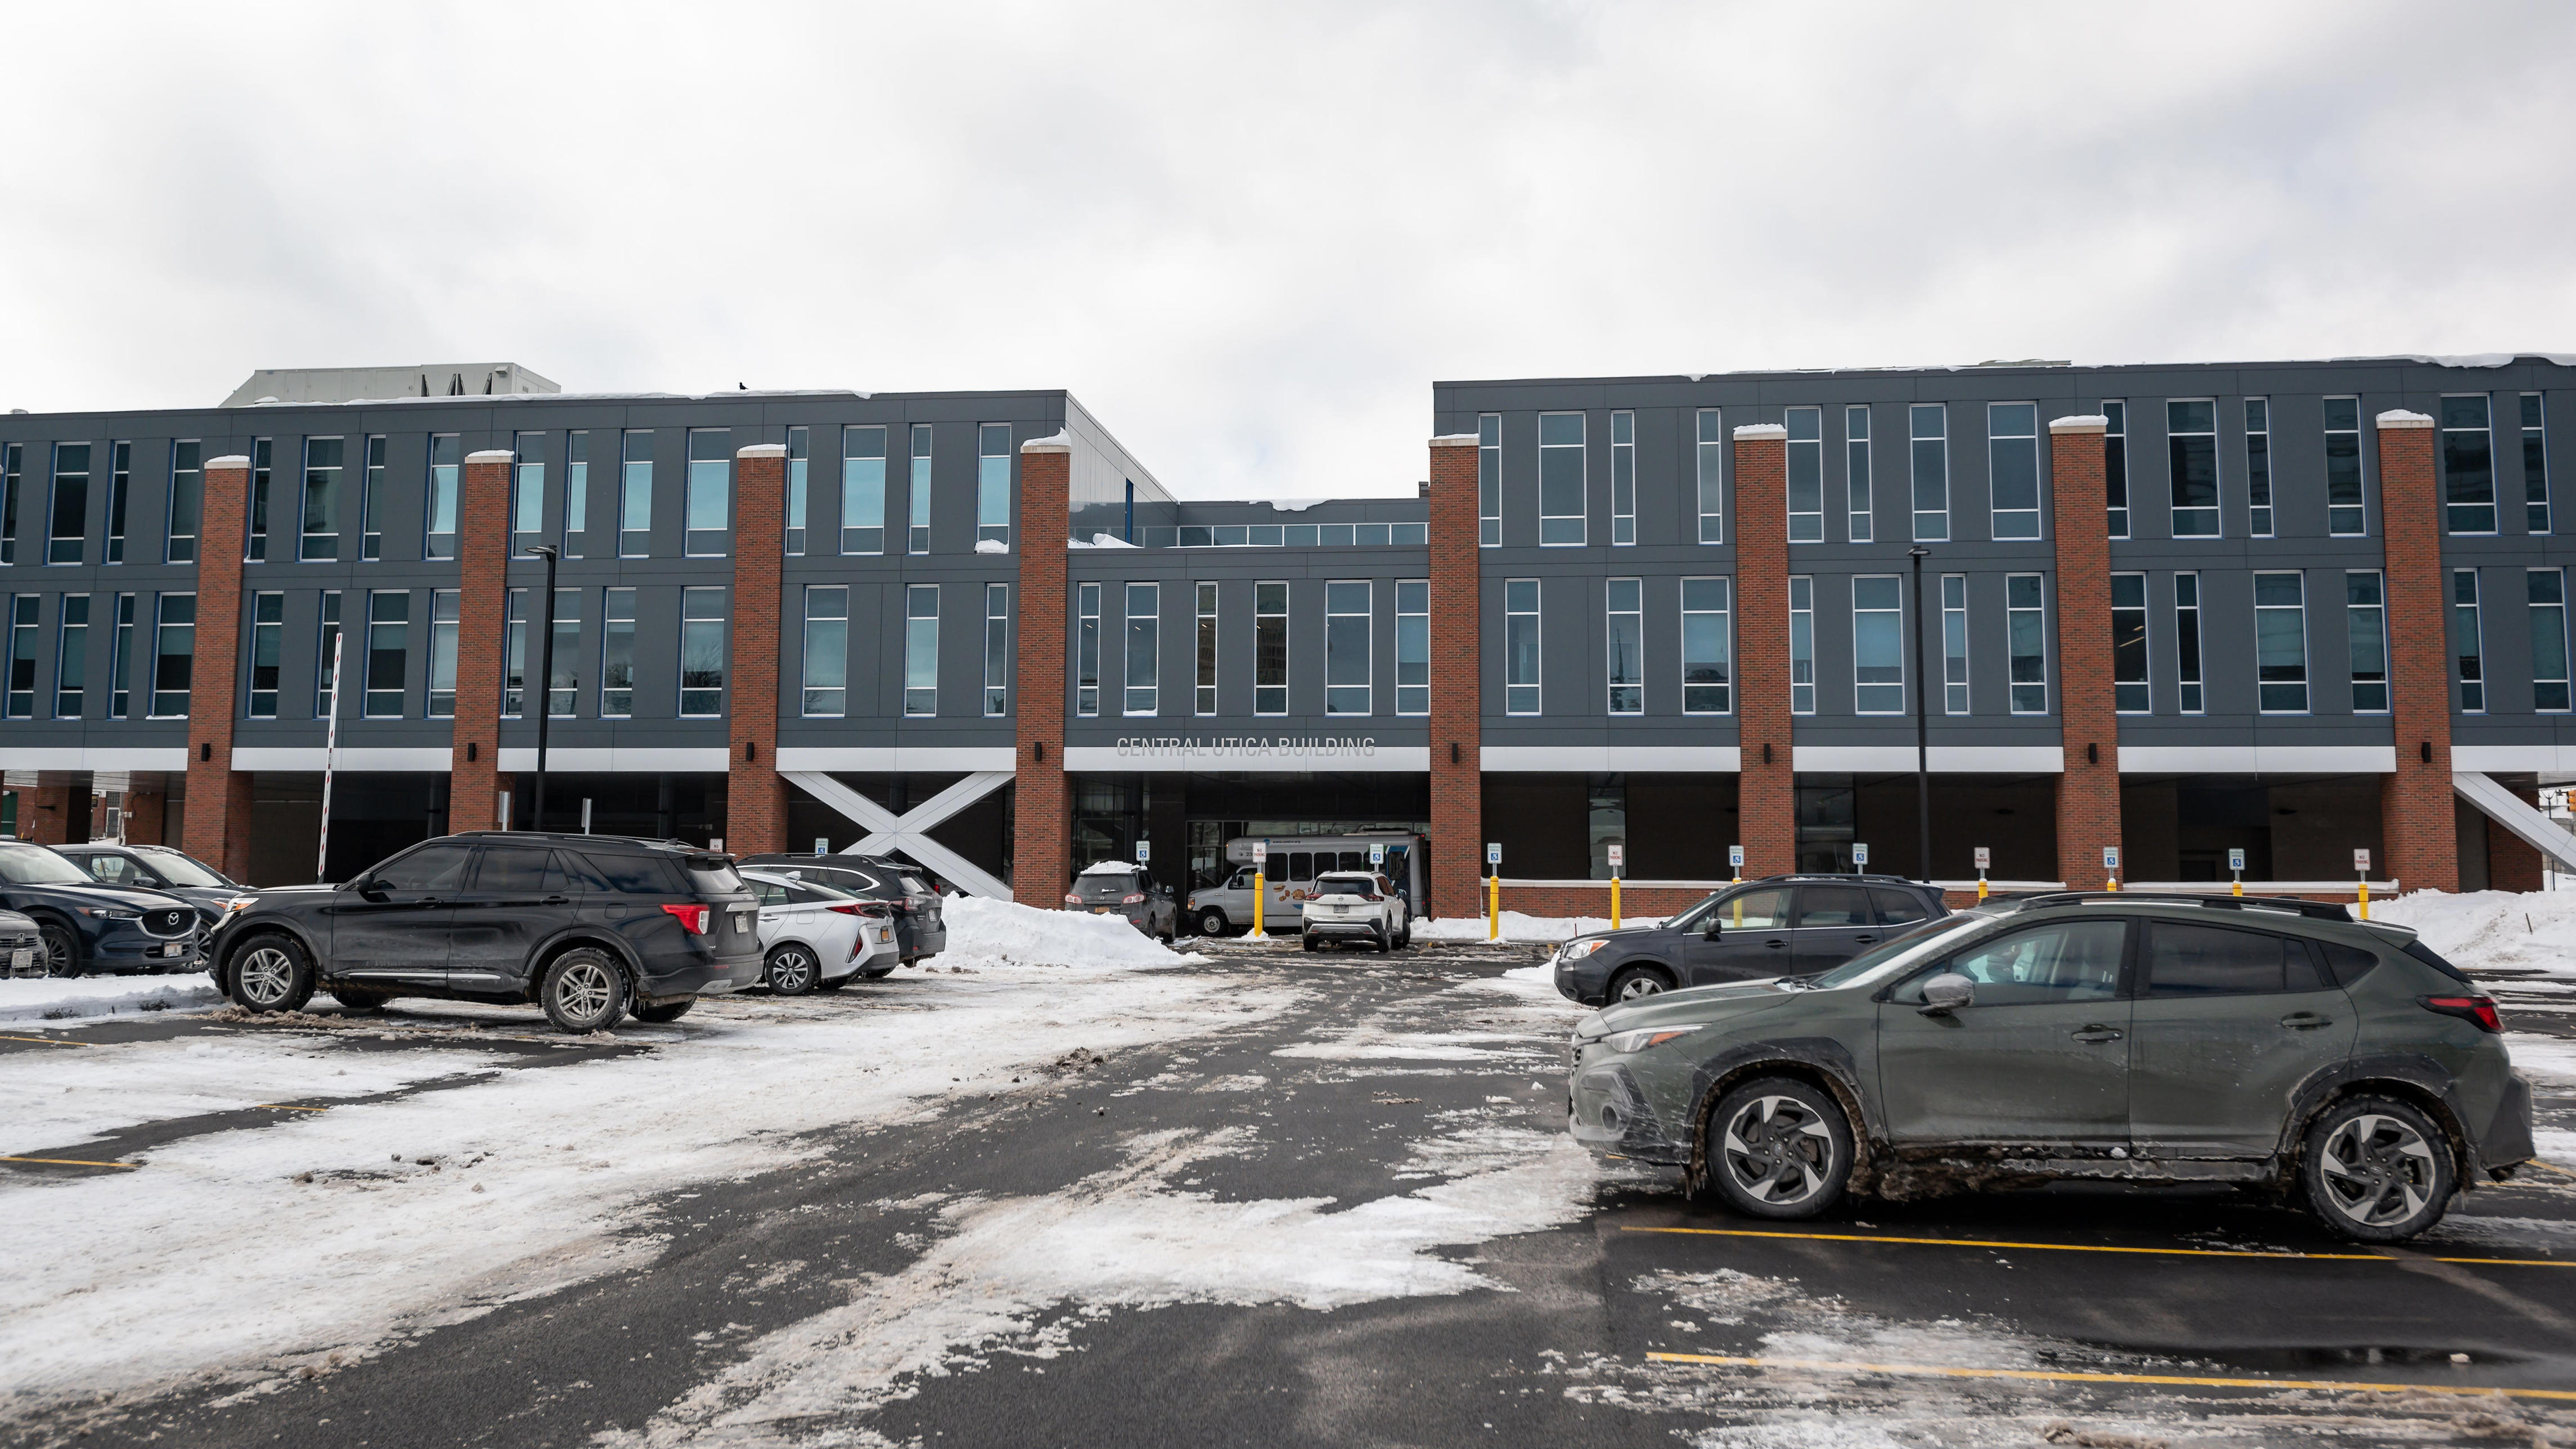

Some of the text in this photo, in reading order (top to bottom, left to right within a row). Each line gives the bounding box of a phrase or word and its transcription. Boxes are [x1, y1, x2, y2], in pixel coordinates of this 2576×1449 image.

[1117, 737, 1375, 757] CENTRAL UTICA BUILDING
